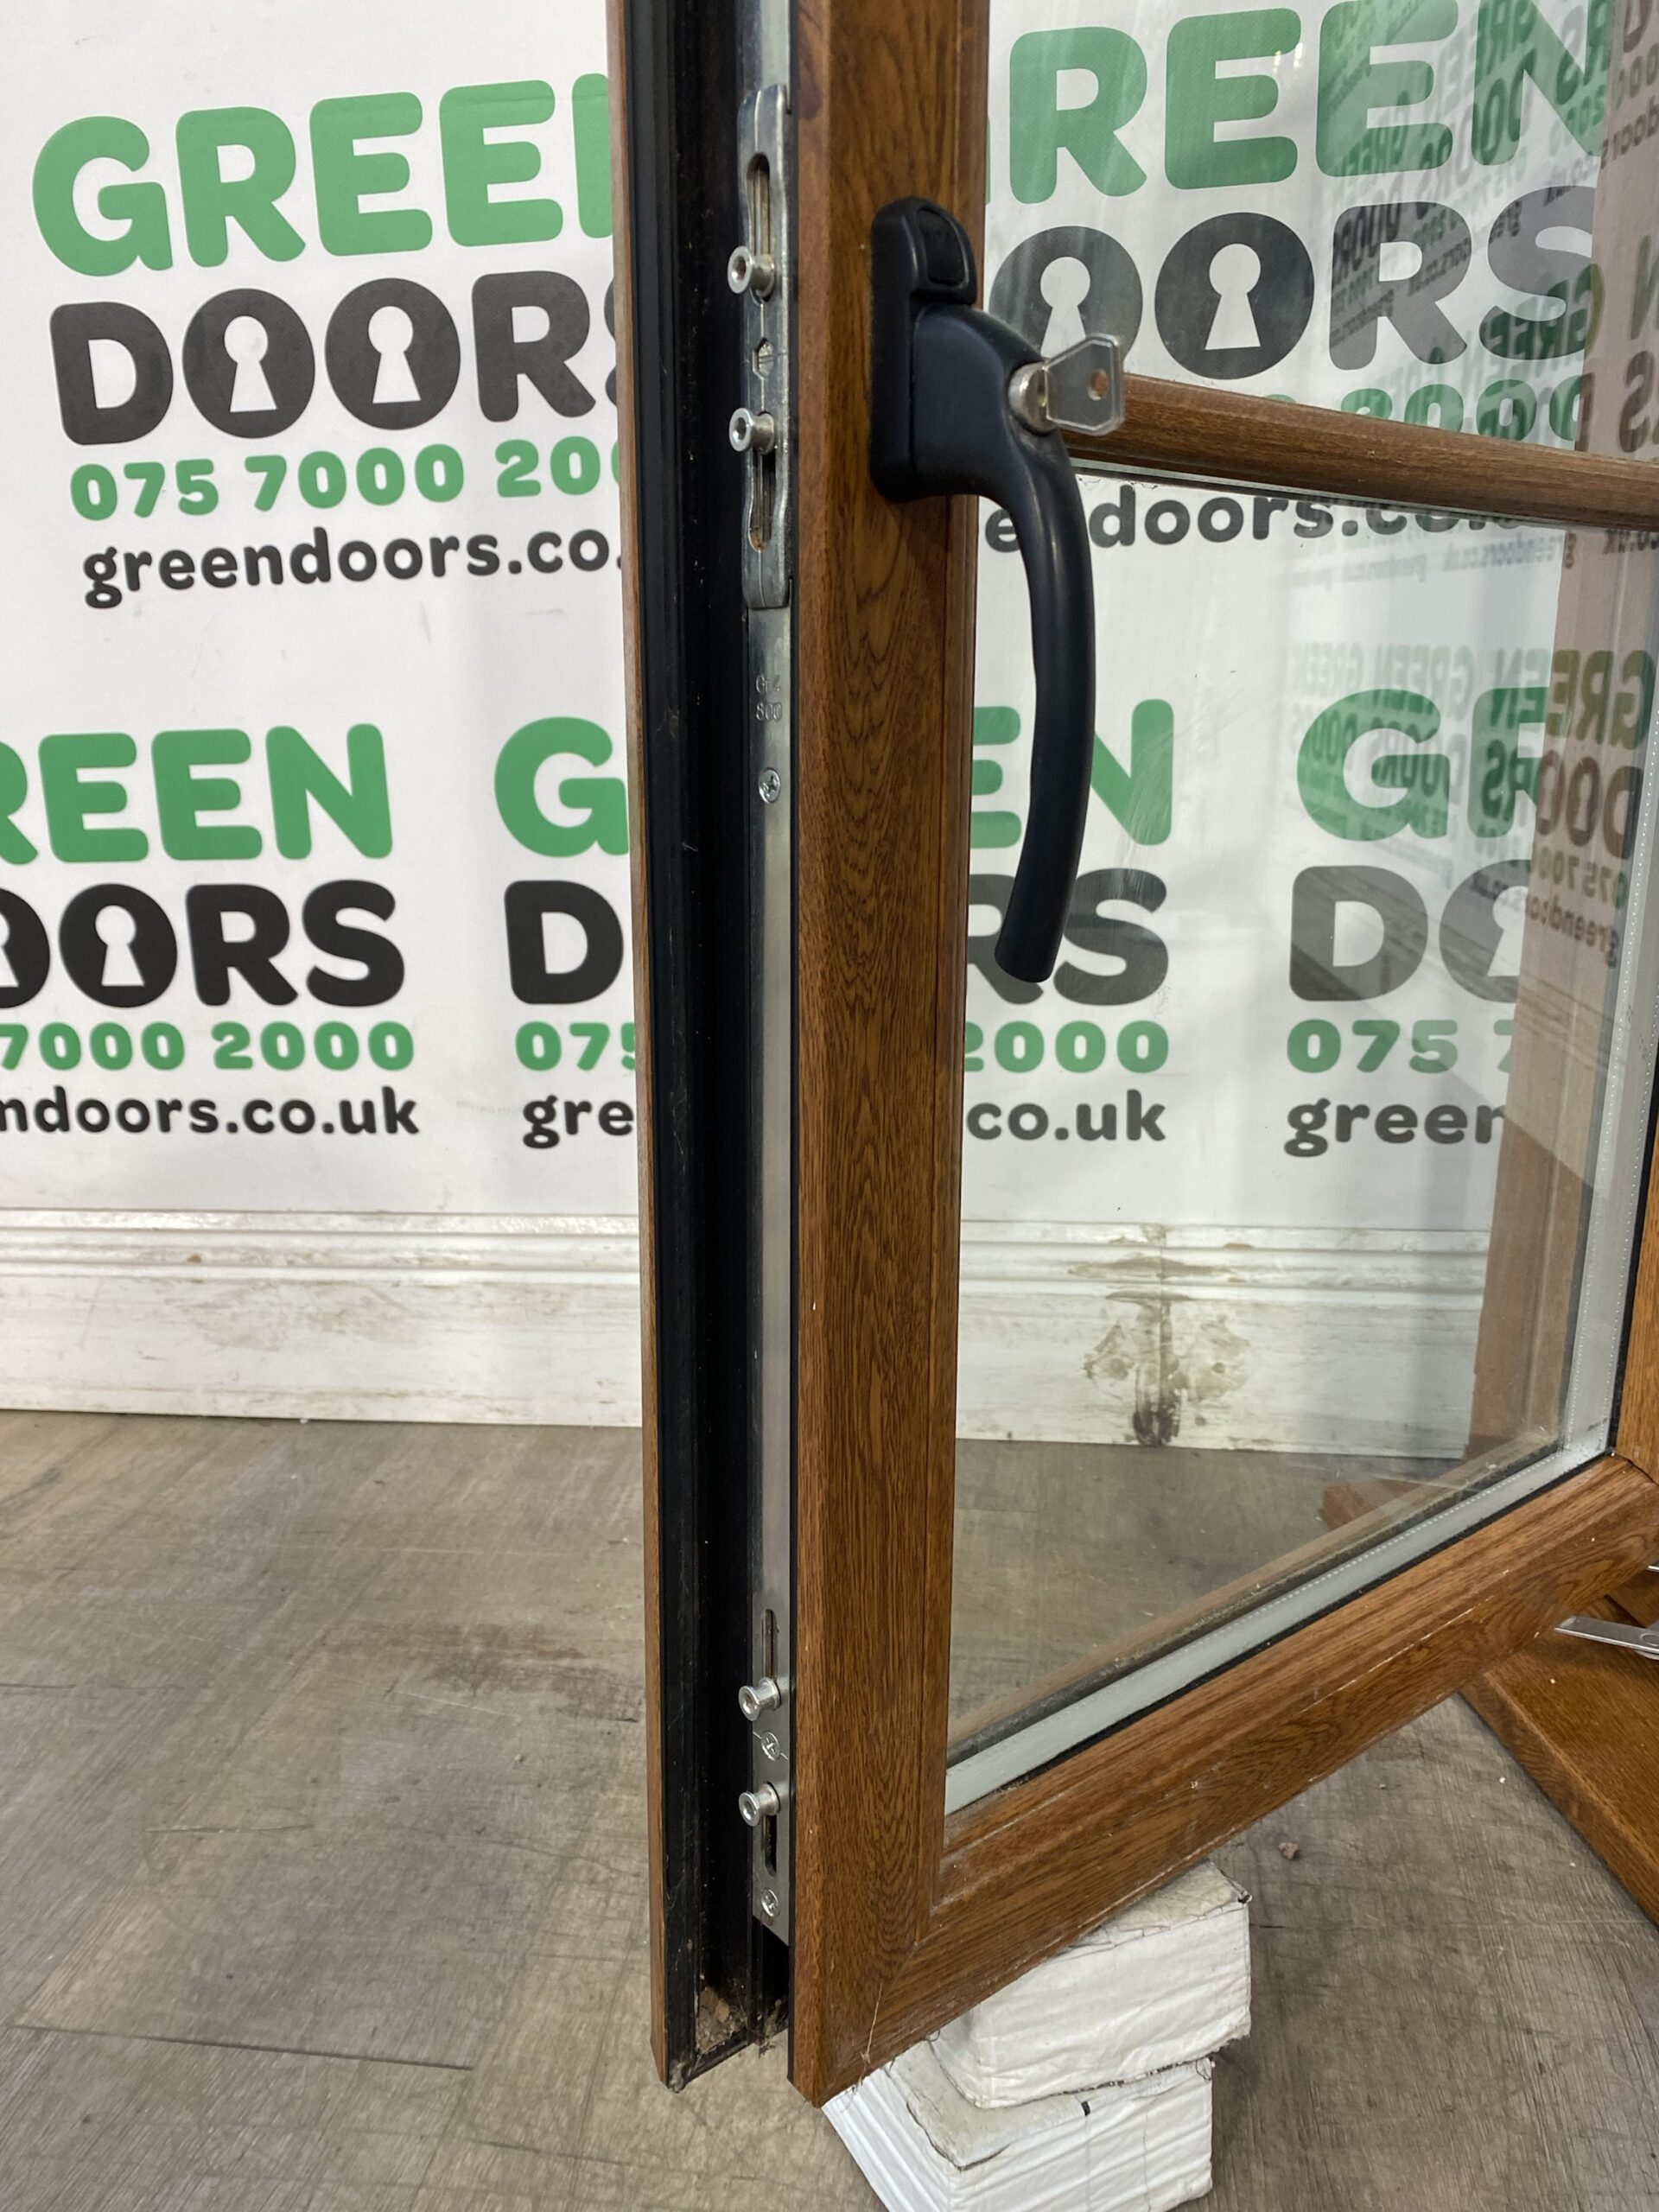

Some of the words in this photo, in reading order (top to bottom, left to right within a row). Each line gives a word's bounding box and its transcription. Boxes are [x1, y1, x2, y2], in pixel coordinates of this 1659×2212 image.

[986, 0, 1611, 205] REEN
[49, 270, 618, 445] DOOR
[70, 459, 219, 520] 075
[245, 443, 464, 512] 7000
[495, 436, 620, 499] 20
[211, 1021, 414, 1071] 2000
[1287, 1019, 1459, 1074] 075
[966, 1089, 1166, 1141] co.uk
